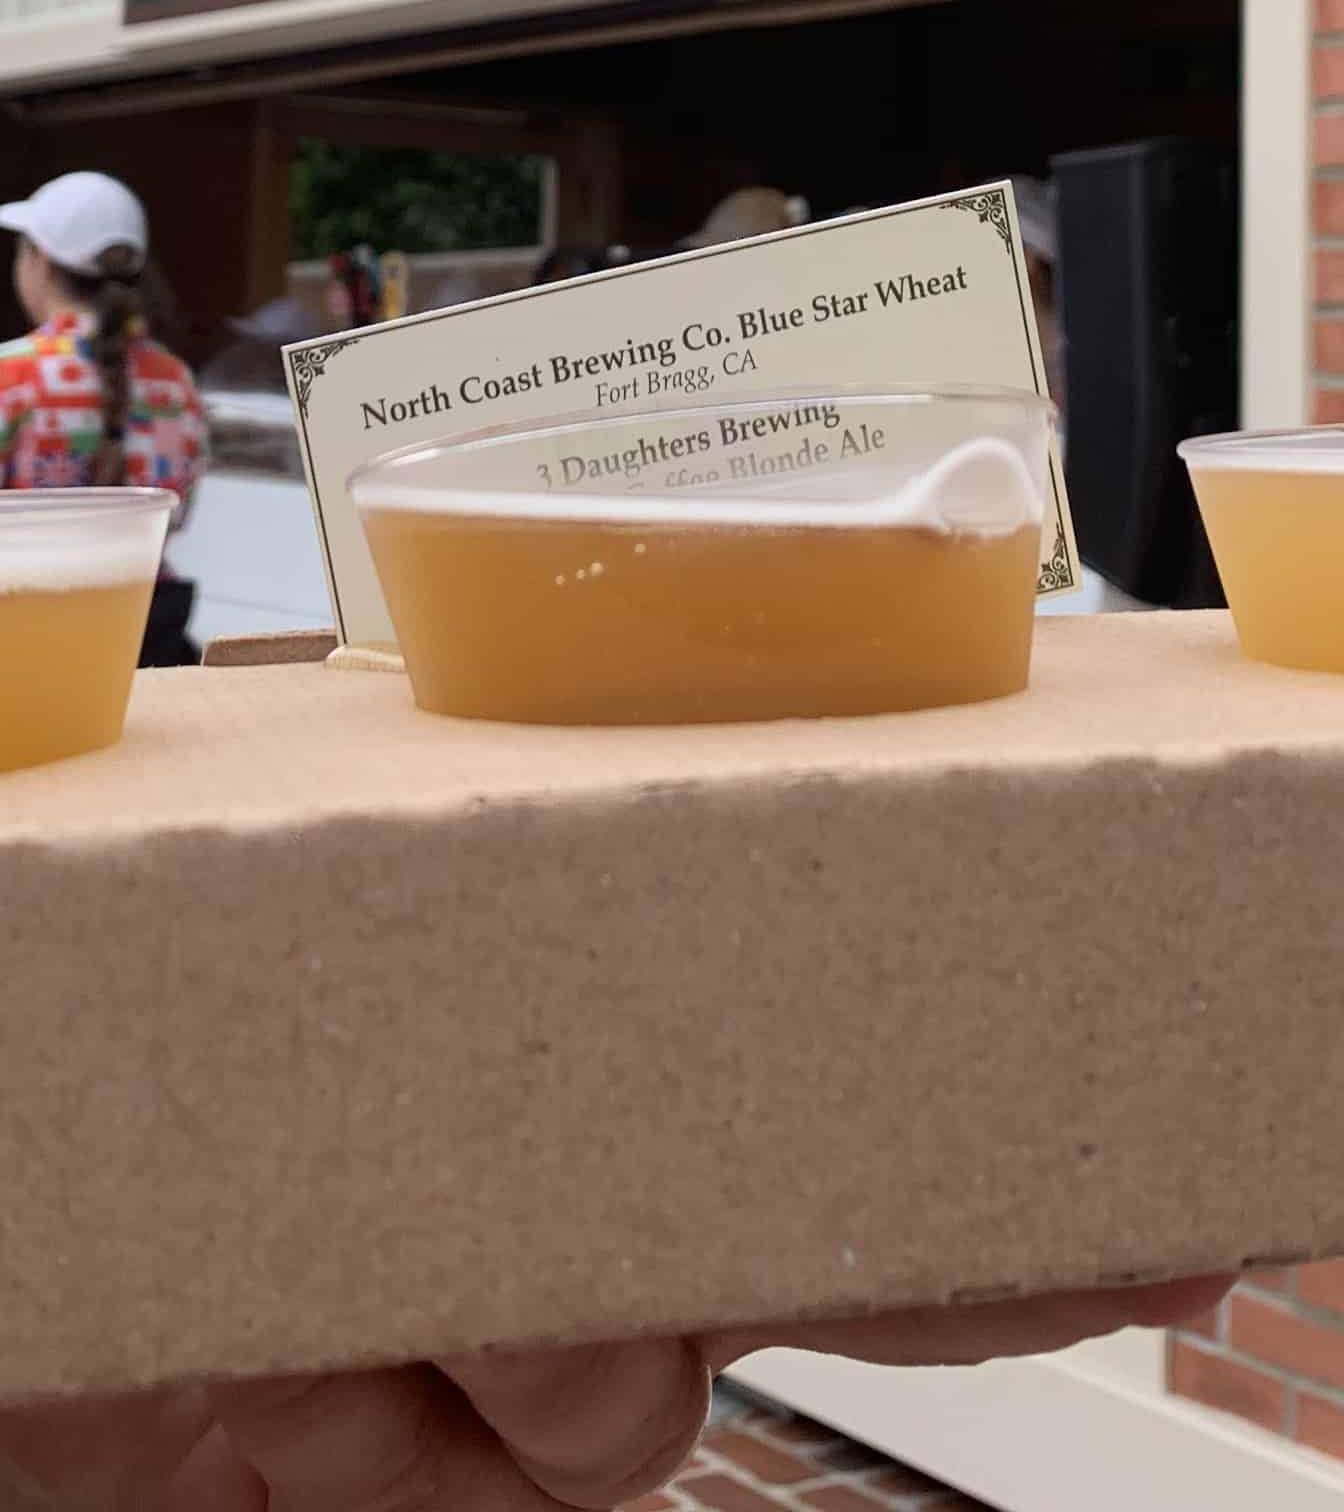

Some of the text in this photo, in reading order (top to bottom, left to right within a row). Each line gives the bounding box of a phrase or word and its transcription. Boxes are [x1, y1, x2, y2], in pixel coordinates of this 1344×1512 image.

[359, 265, 968, 430] North Coast Brewing Co. Blue Star Wheat
[595, 349, 759, 407] Fort Bragg, CA
[536, 405, 841, 489] 3 Daughters Brewing
[727, 438, 829, 483] Blonde
[839, 423, 887, 461] Ale
